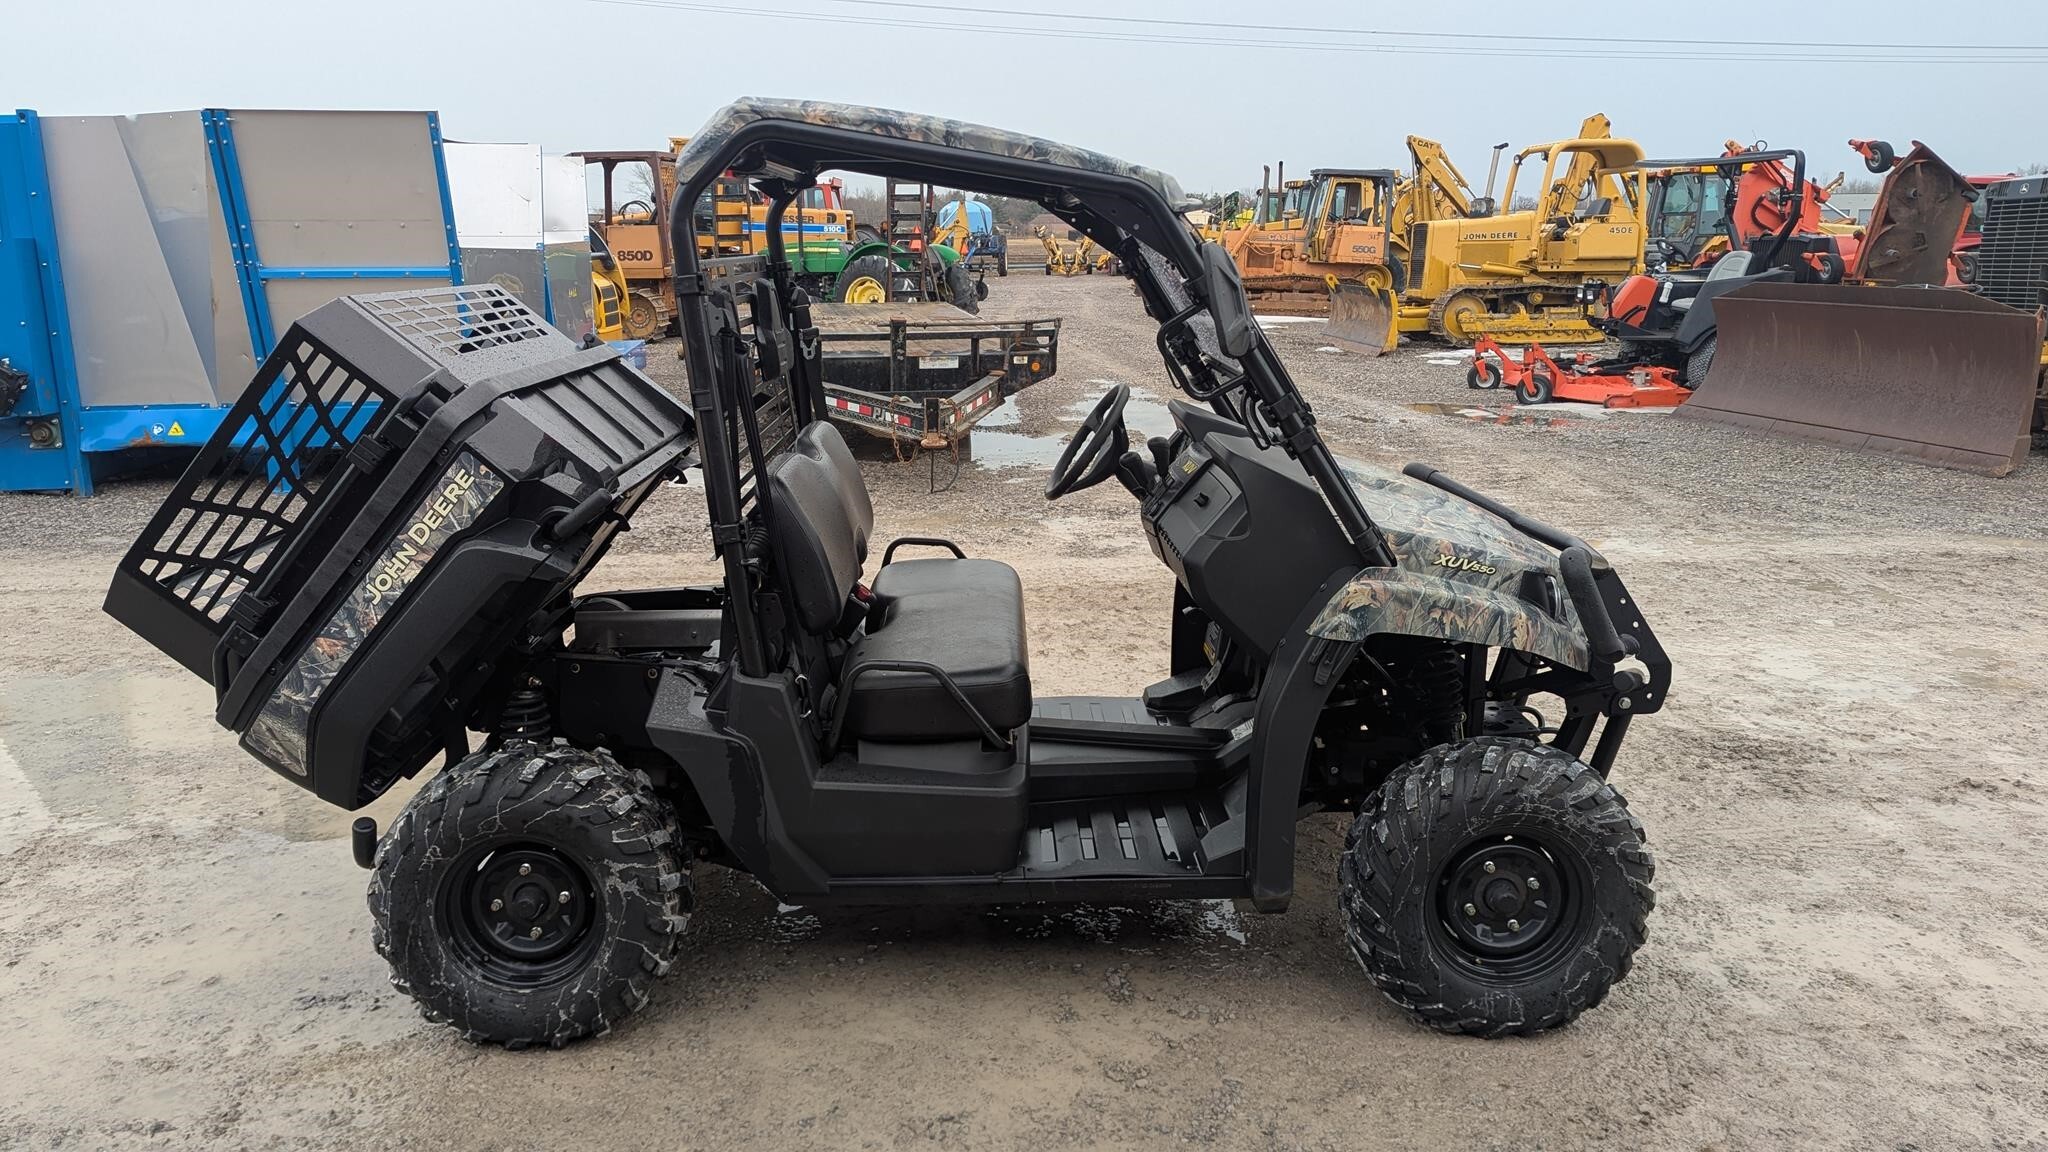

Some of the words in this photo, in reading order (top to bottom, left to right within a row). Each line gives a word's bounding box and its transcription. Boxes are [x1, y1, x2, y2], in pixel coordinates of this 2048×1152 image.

[1417, 139, 1434, 149] CAT
[1609, 226, 1633, 234] 450E
[1464, 231, 1487, 240] JOHN
[1490, 231, 1518, 239] DEERE
[1352, 245, 1376, 254] 550G
[617, 250, 653, 261] 850D
[365, 542, 418, 606] JOHN
[407, 468, 475, 546] DEERE
[1432, 553, 1496, 576] XUV550
